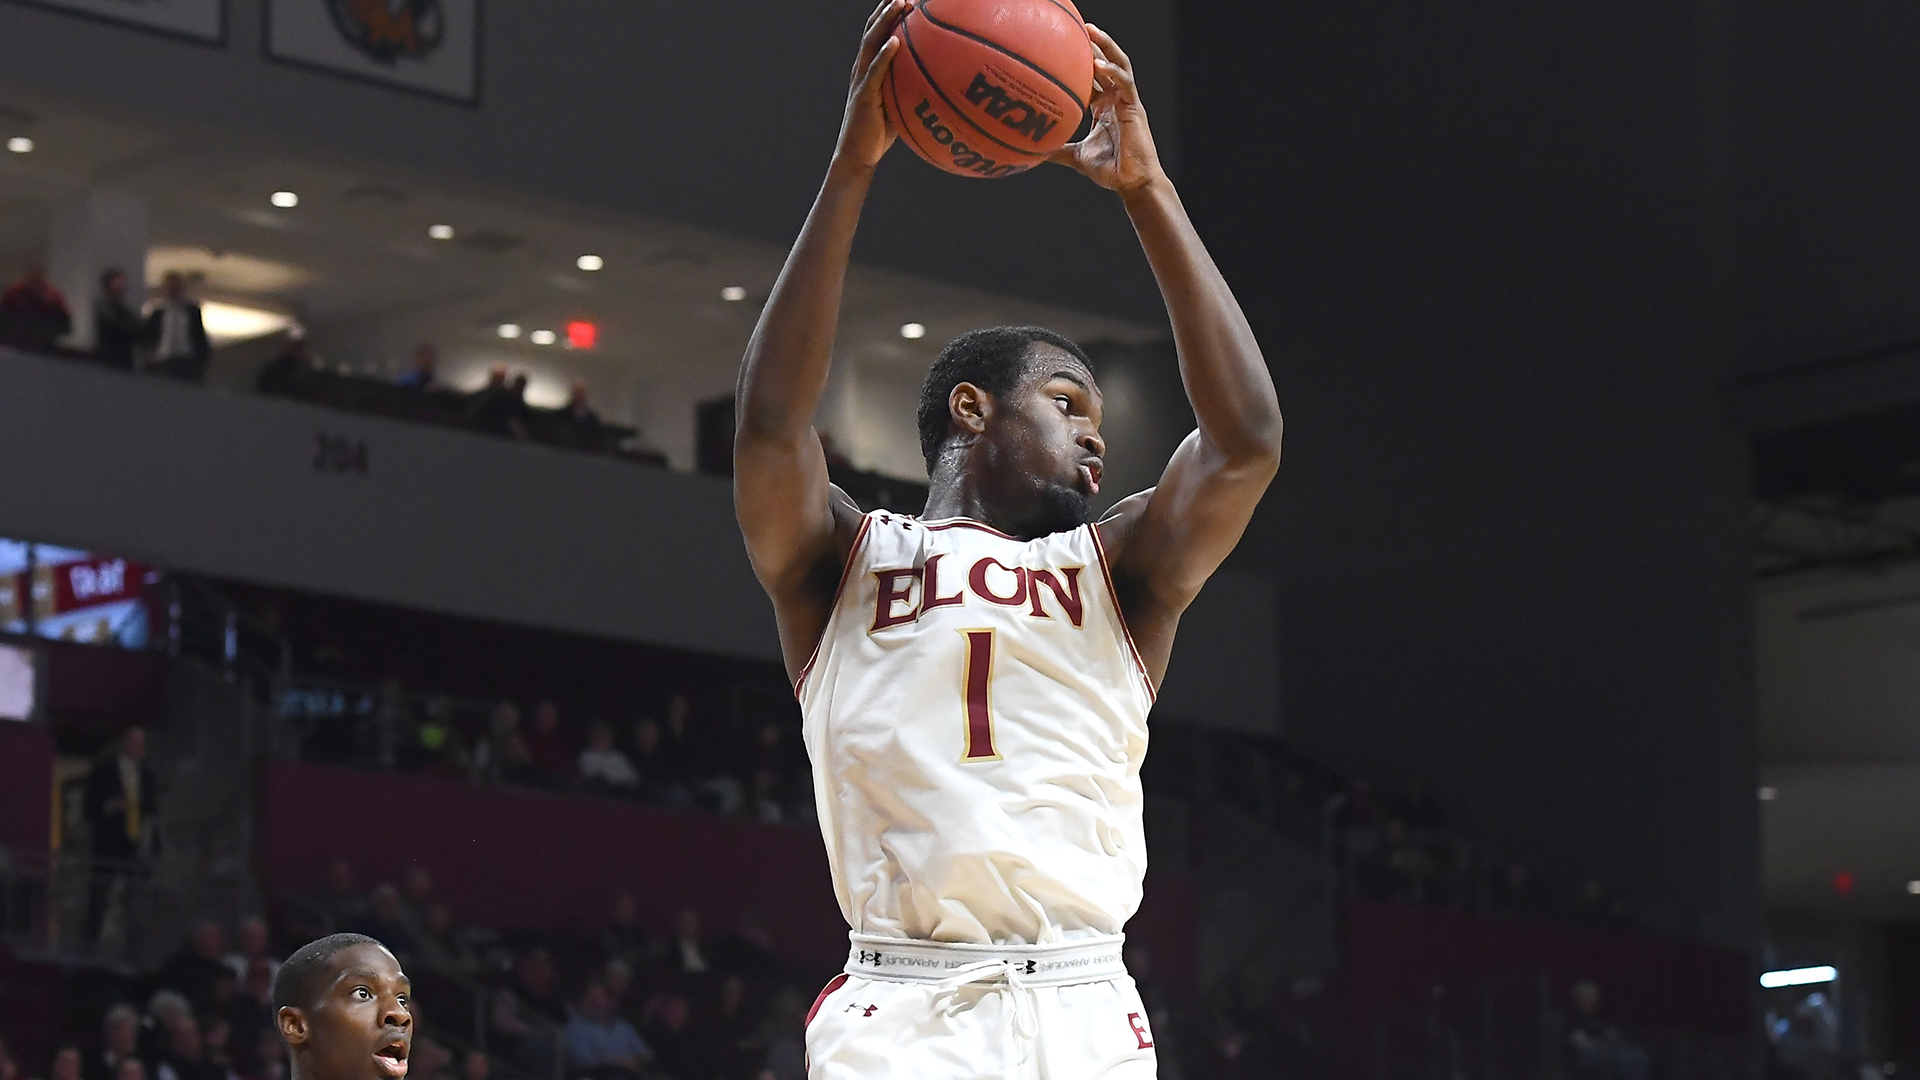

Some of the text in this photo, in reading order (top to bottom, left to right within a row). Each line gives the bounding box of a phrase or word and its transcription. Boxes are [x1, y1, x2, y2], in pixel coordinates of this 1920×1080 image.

[964, 72, 1058, 142] NCAA
[867, 554, 1085, 636] ELON
[955, 627, 1004, 764] 1
[1127, 1012, 1154, 1051] E
